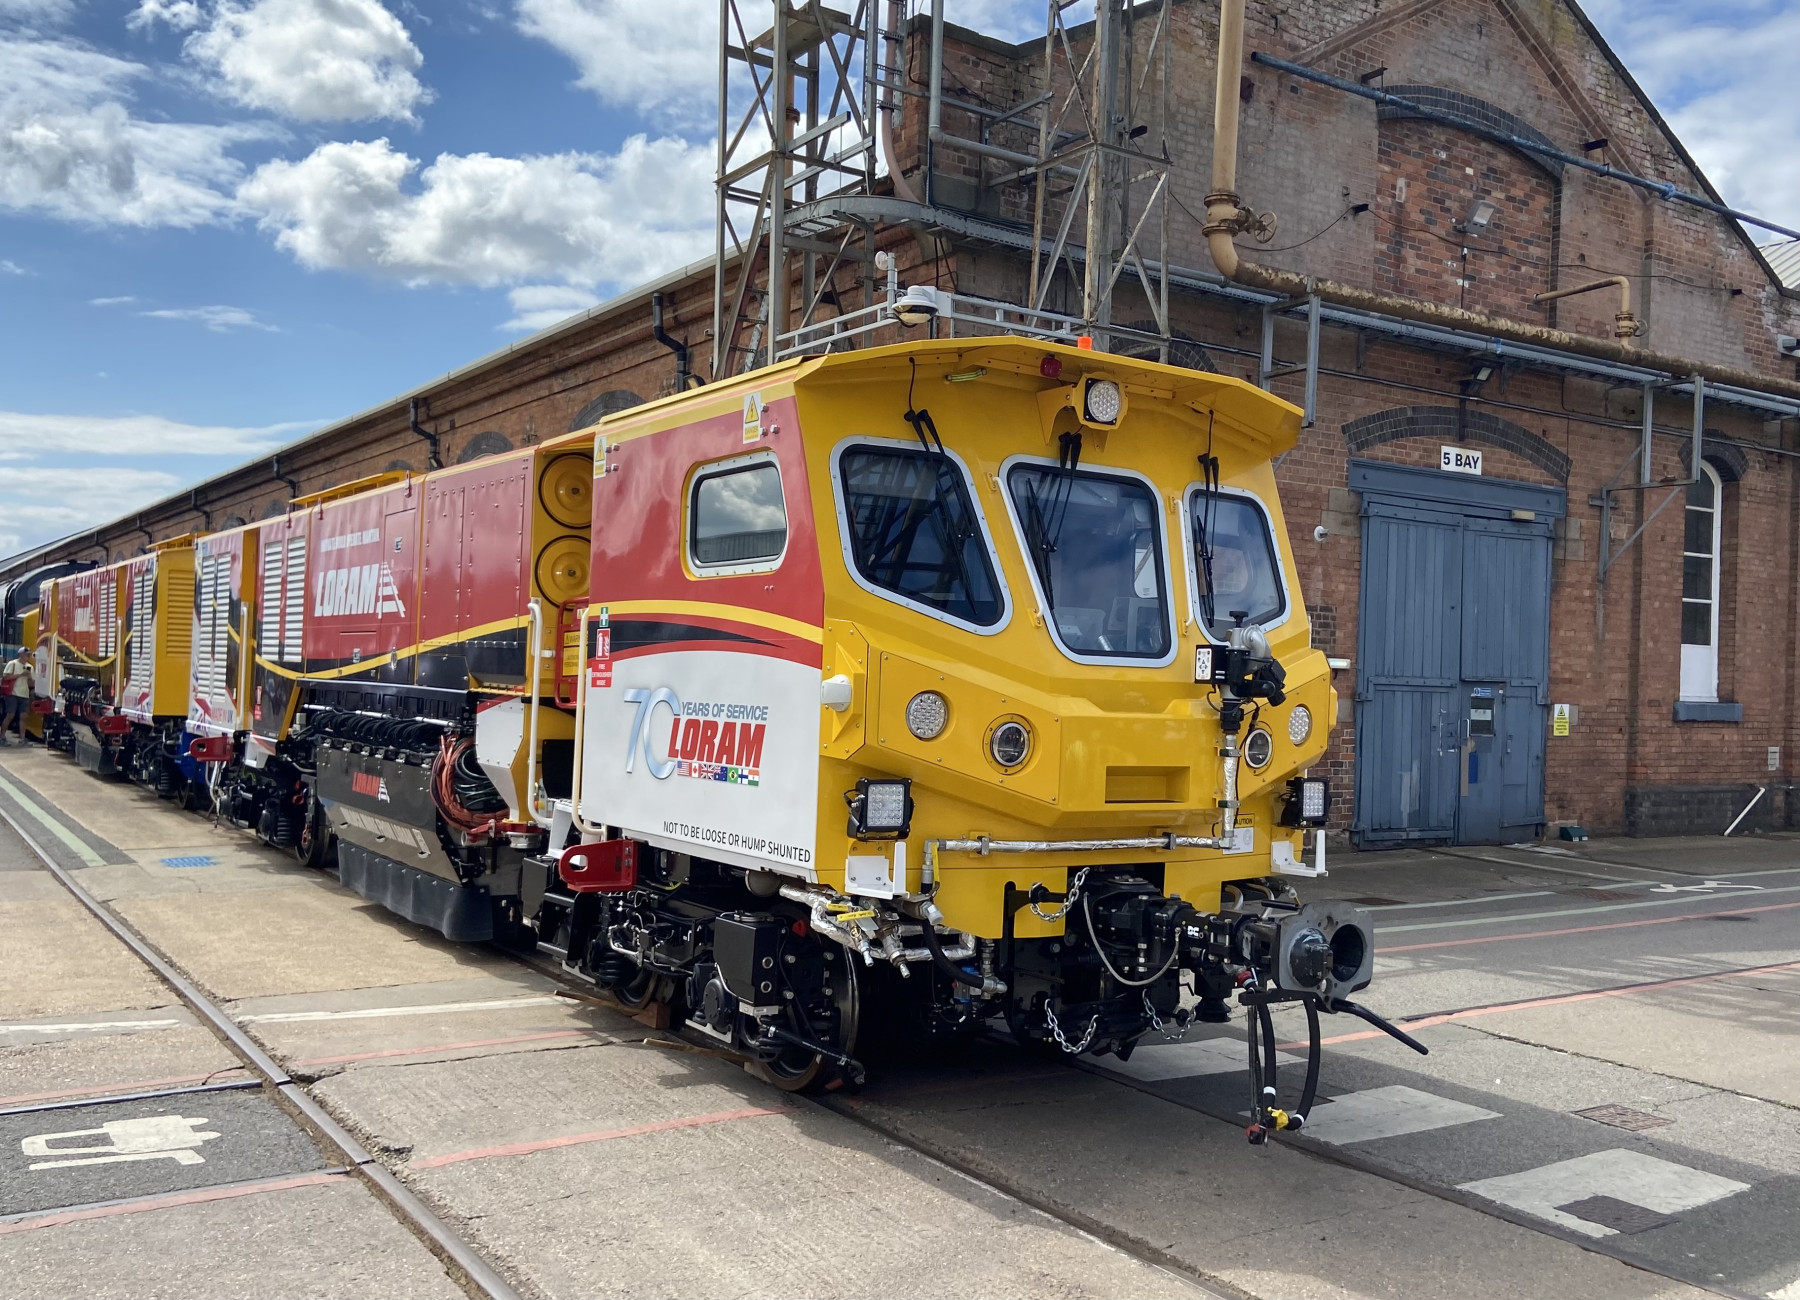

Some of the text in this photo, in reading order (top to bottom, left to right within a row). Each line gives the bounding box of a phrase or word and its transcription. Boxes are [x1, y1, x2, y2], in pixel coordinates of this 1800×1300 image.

[1443, 452, 1479, 469] 5 BAY
[314, 563, 379, 617] LORAM
[681, 701, 769, 721] YEARS OF SERVICE
[667, 717, 766, 768] LORAM
[352, 771, 380, 797] LORAM
[663, 820, 811, 863] NOT TO BE LOOSE OR HUMP SHUNTED
